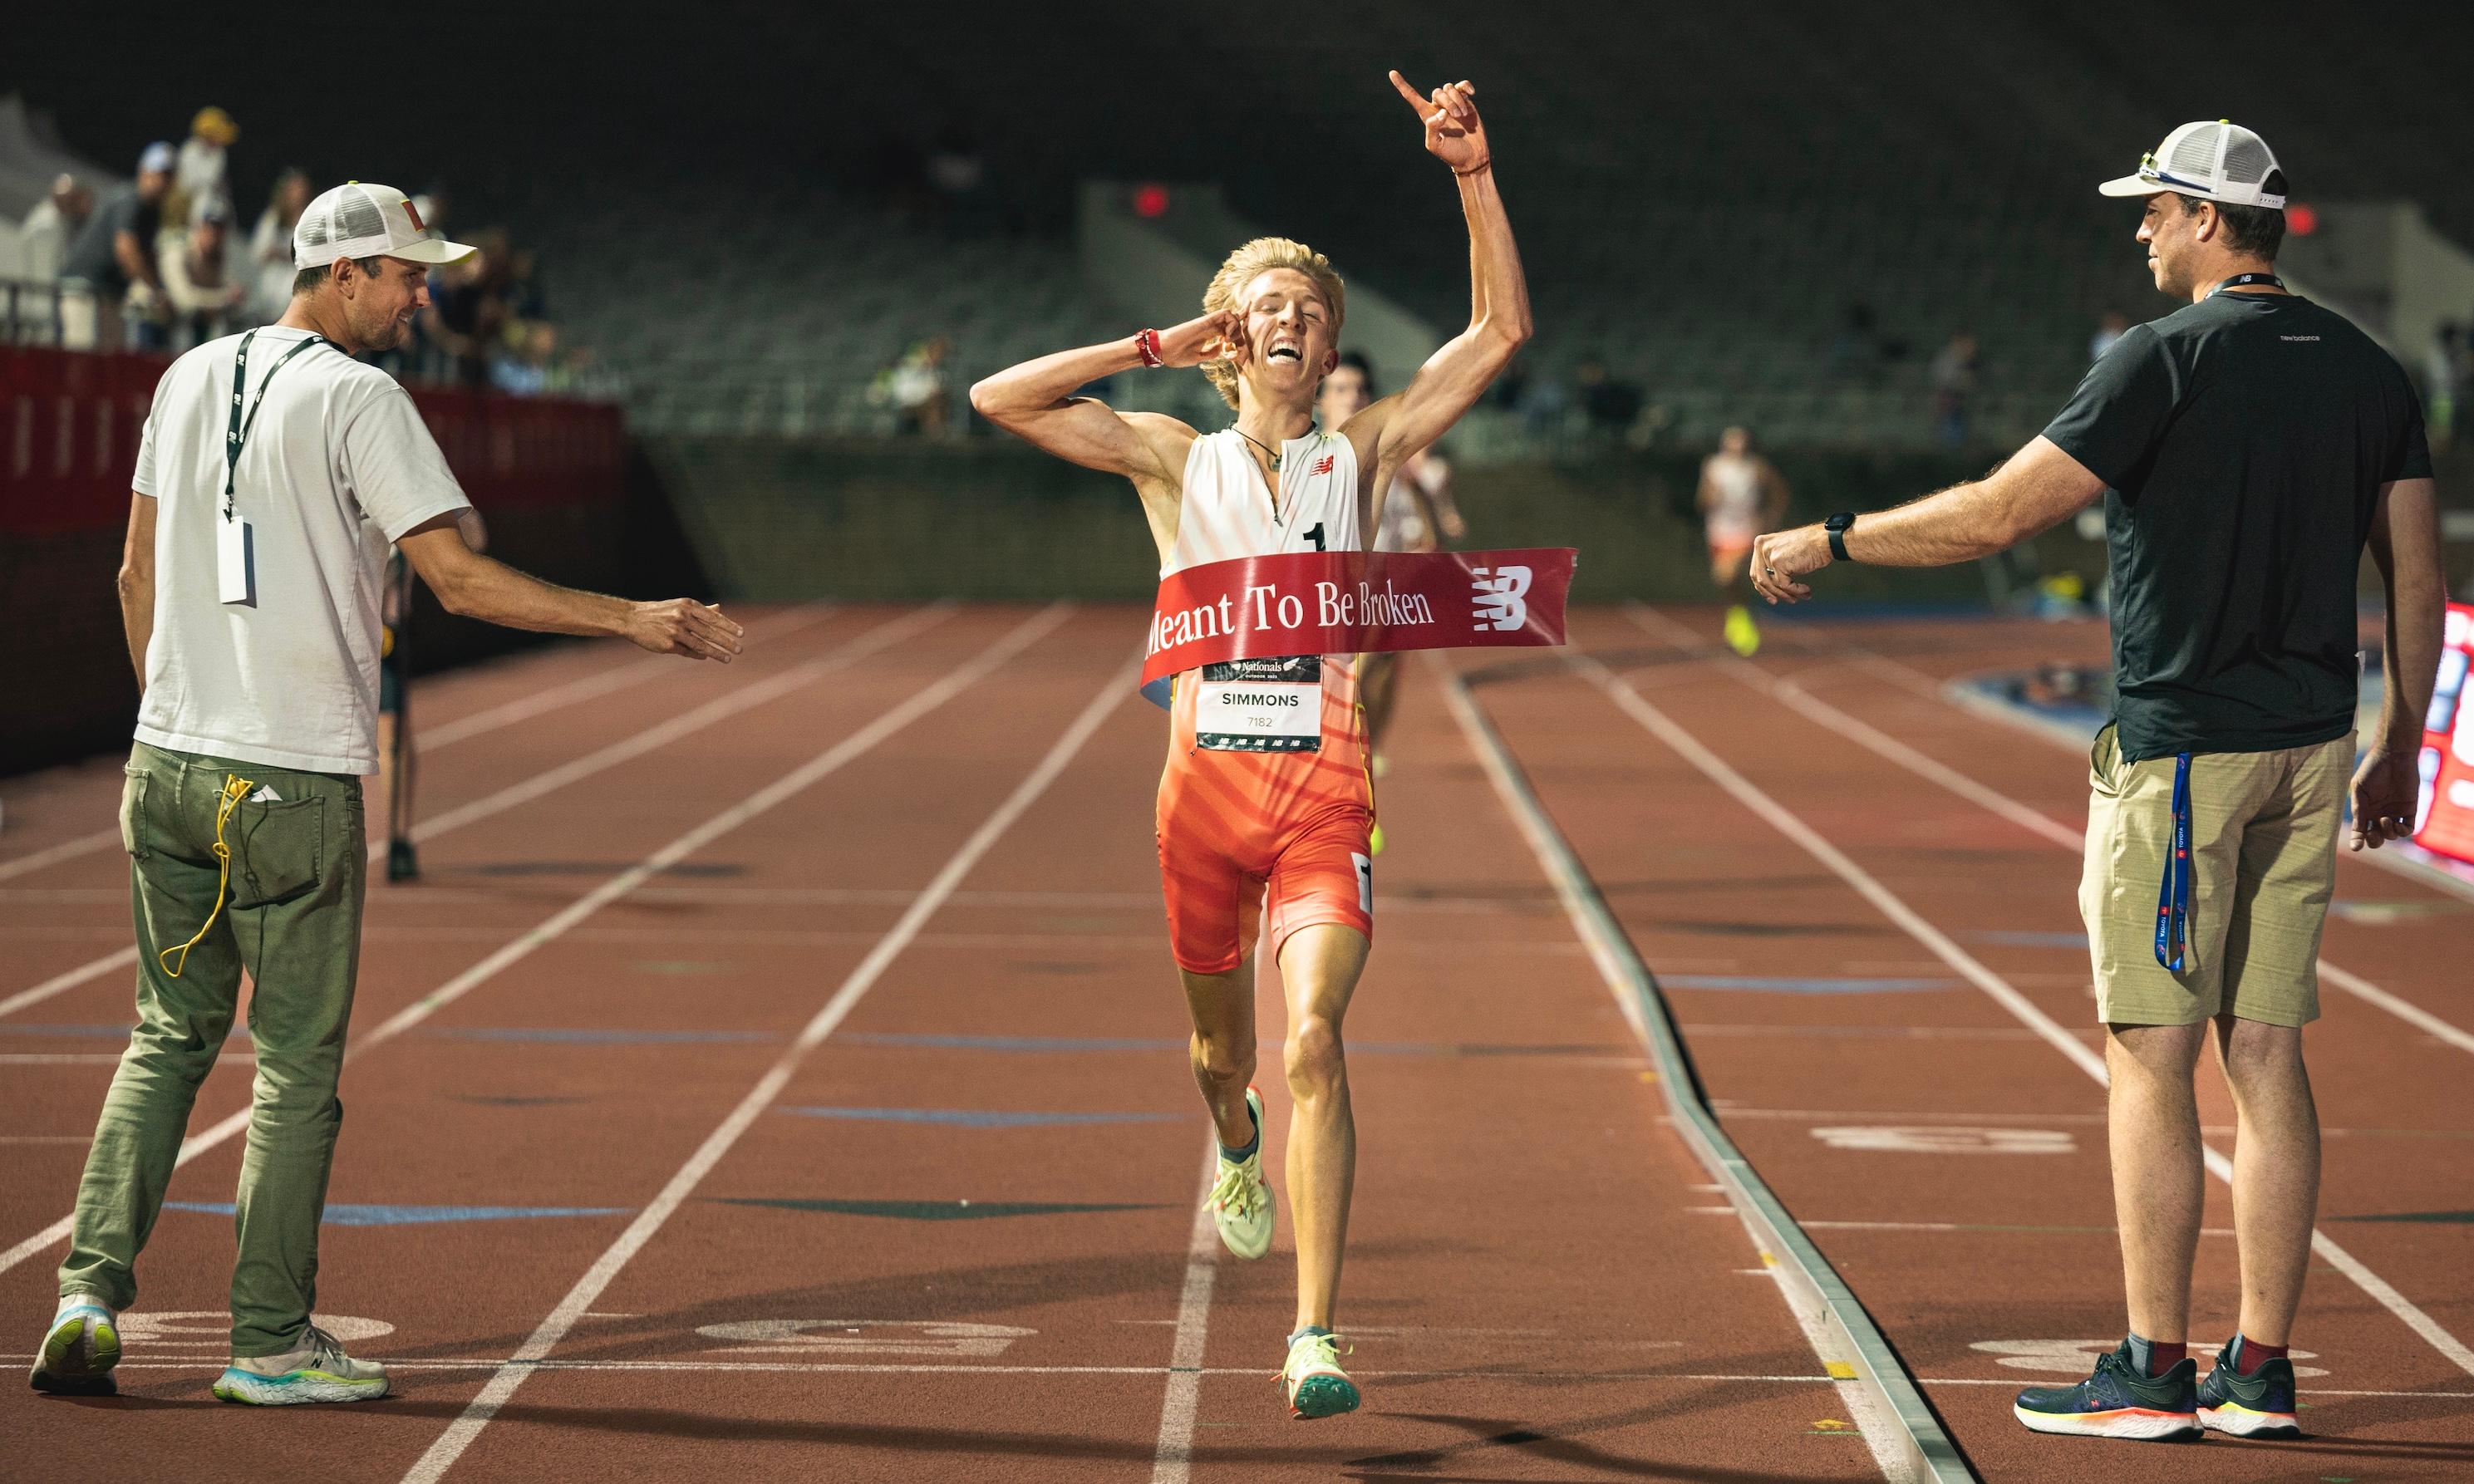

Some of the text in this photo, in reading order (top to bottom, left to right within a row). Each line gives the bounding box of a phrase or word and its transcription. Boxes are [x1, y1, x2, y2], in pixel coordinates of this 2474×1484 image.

[2240, 275, 2252, 283] NB
[1248, 583, 1304, 631] To
[1315, 581, 1355, 627] Be
[1359, 578, 1435, 627] Broken
[1472, 566, 1532, 631] NB
[1242, 661, 1282, 672] Nationals
[1222, 693, 1299, 707] SIMMONS
[1247, 717, 1273, 727] 7182
